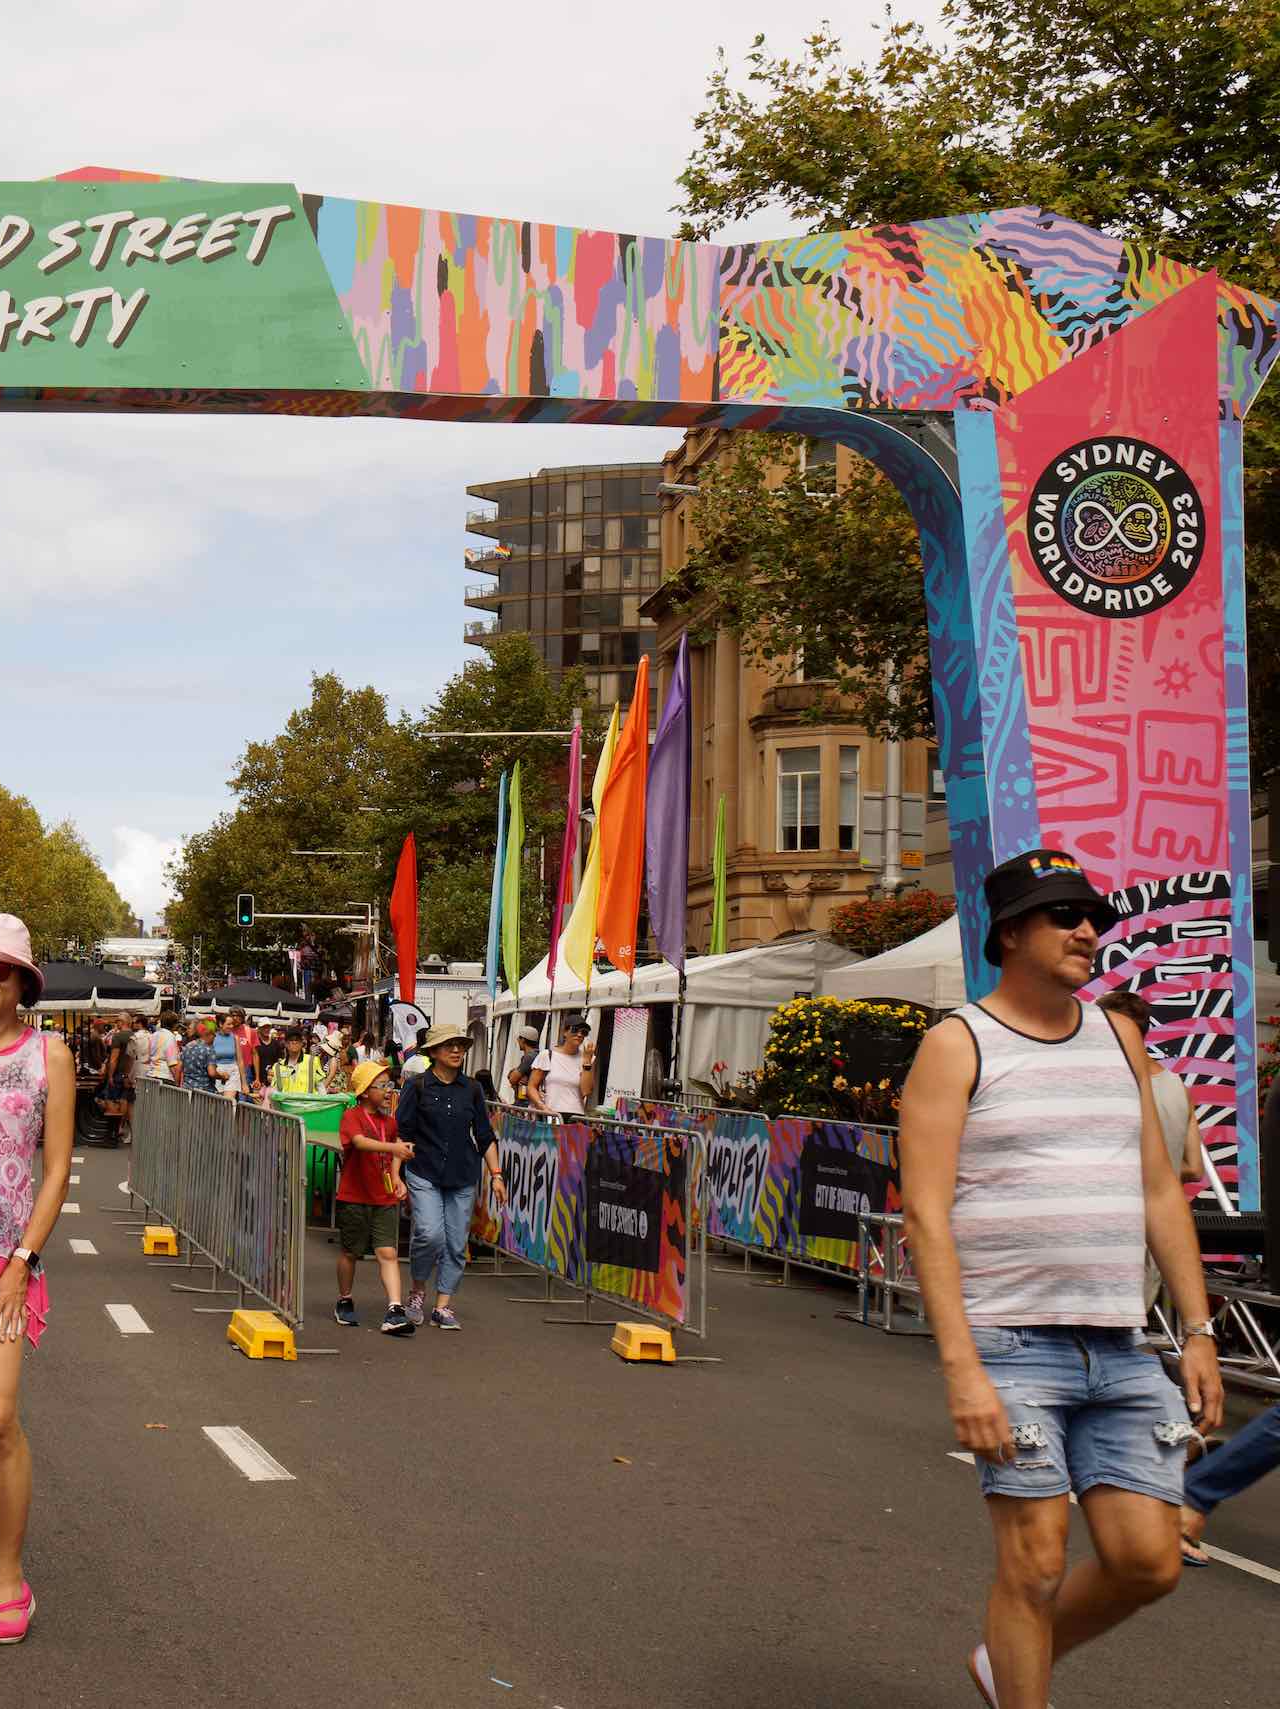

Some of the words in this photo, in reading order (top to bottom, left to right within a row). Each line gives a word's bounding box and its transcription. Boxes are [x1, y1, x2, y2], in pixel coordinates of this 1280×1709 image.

[39, 205, 294, 272] STREET
[1056, 443, 1175, 484] SYDNEY
[1034, 493, 1173, 611] WORLDPRIDE
[1171, 492, 1198, 569] 2023
[599, 1201, 610, 1230] CITY
[816, 1183, 829, 1208] CITY
[836, 1188, 861, 1215] SYDNEY
